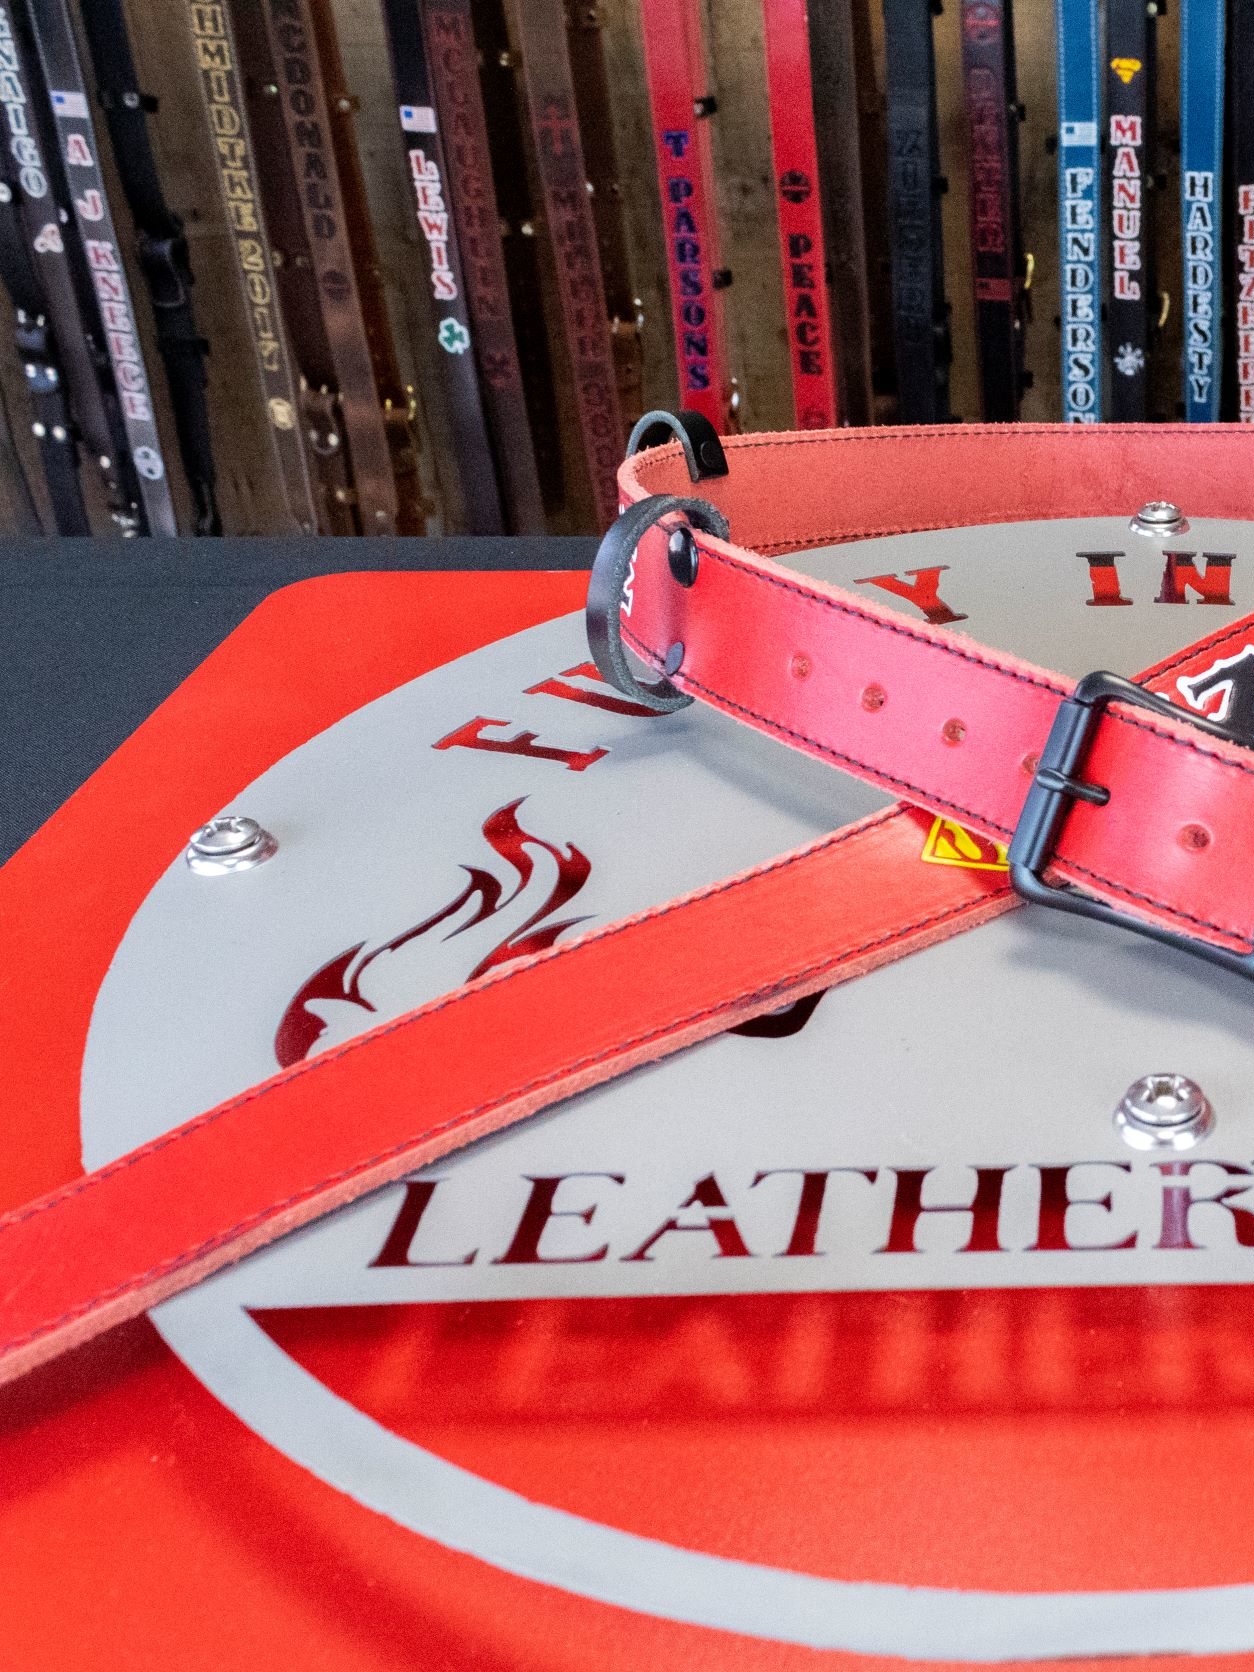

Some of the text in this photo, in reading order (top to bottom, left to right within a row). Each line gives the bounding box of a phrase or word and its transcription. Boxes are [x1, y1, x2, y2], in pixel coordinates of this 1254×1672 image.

[67, 133, 94, 166] A
[76, 189, 104, 221] J
[1110, 115, 1142, 300] MANUEL
[409, 150, 457, 300] LEWIS
[664, 131, 711, 390] T PARSONS
[1185, 171, 1213, 403] HARDESTY
[788, 234, 823, 376] PEACE
